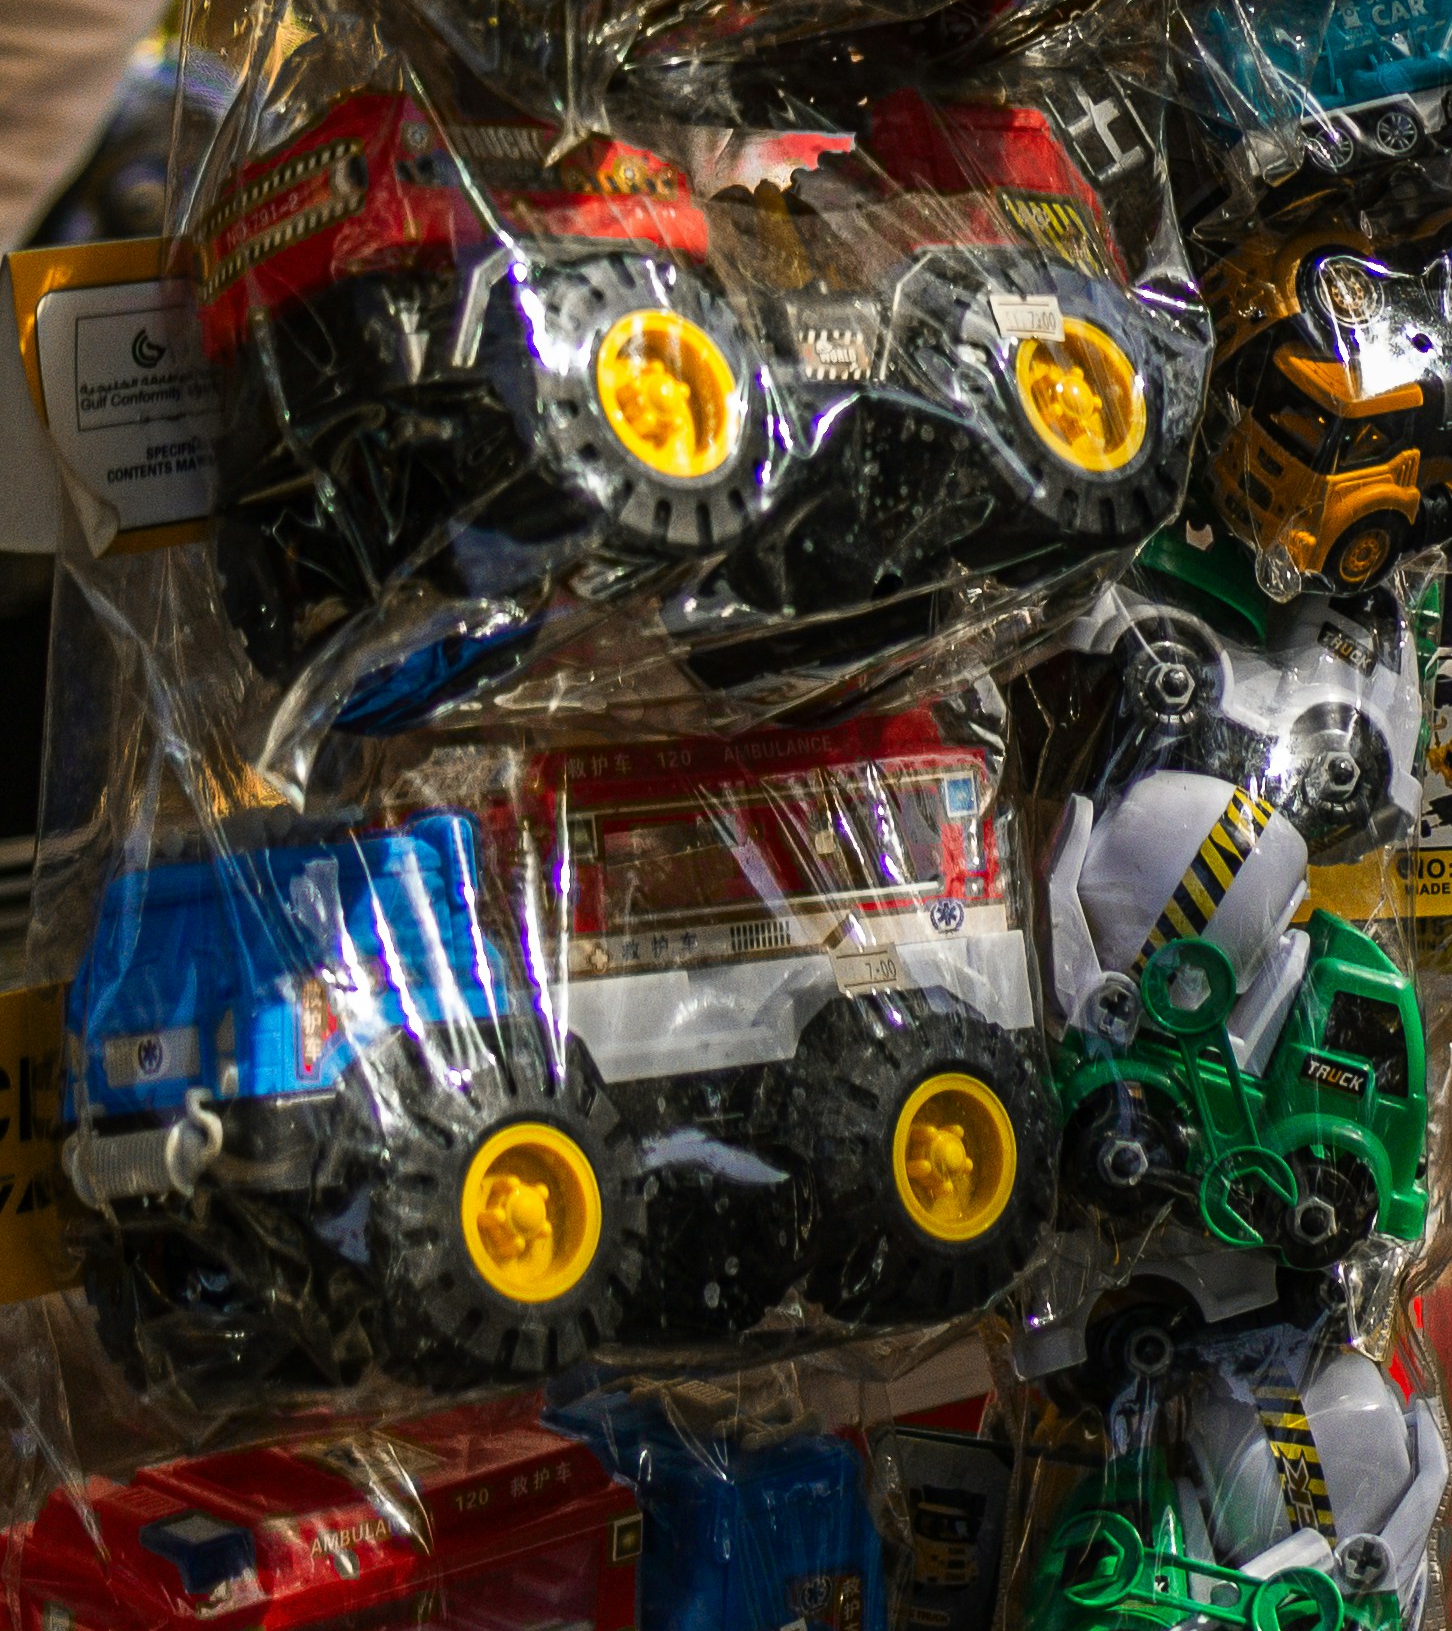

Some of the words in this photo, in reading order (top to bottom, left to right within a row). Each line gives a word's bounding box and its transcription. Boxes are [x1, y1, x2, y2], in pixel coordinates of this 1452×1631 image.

[79, 392, 108, 413] Gulf
[110, 384, 182, 409] Conformity
[107, 461, 174, 484] CONTENTS
[657, 751, 692, 769] 120
[723, 735, 832, 764] AMBULANCE
[1306, 1058, 1367, 1093] TRUCK
[453, 1488, 491, 1512] 120
